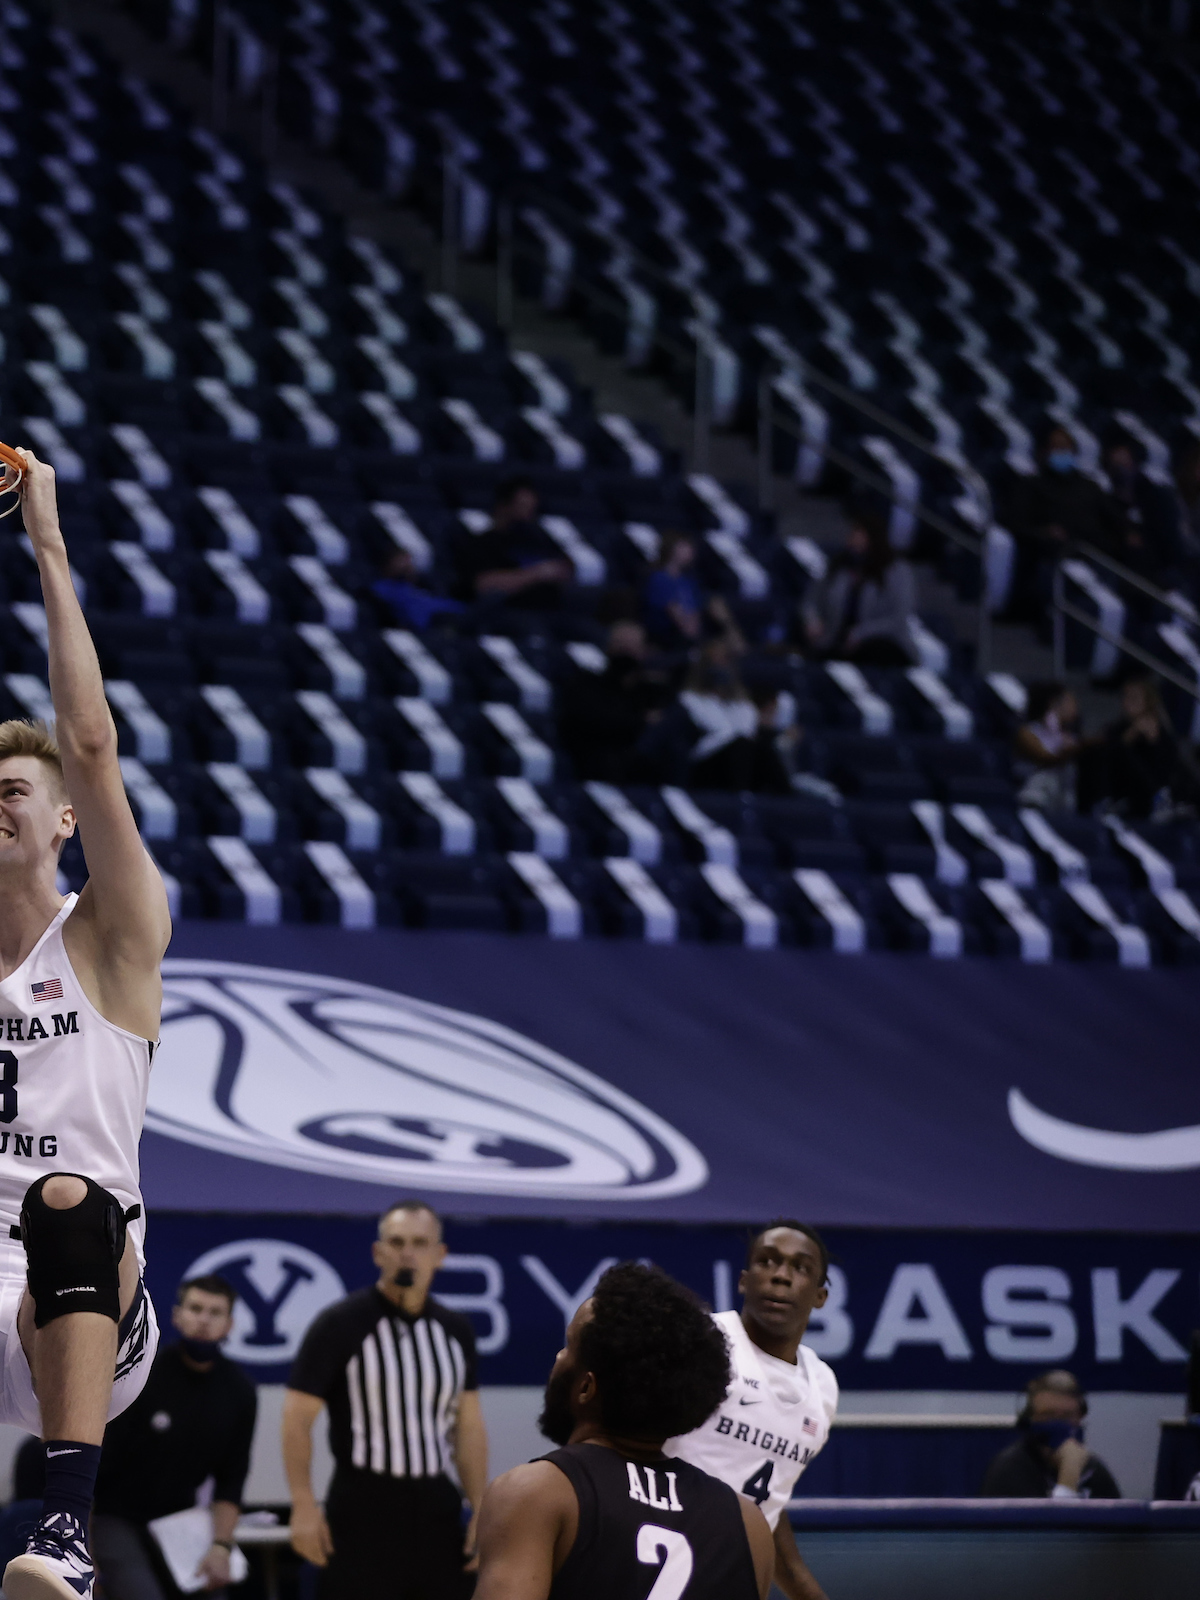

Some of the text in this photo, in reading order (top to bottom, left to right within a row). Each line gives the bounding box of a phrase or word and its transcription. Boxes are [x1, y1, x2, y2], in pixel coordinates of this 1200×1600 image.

[429, 1252, 734, 1358] BY
[626, 1461, 684, 1512] ALI
[742, 1458, 775, 1506] 4
[636, 1522, 694, 1600] 2
